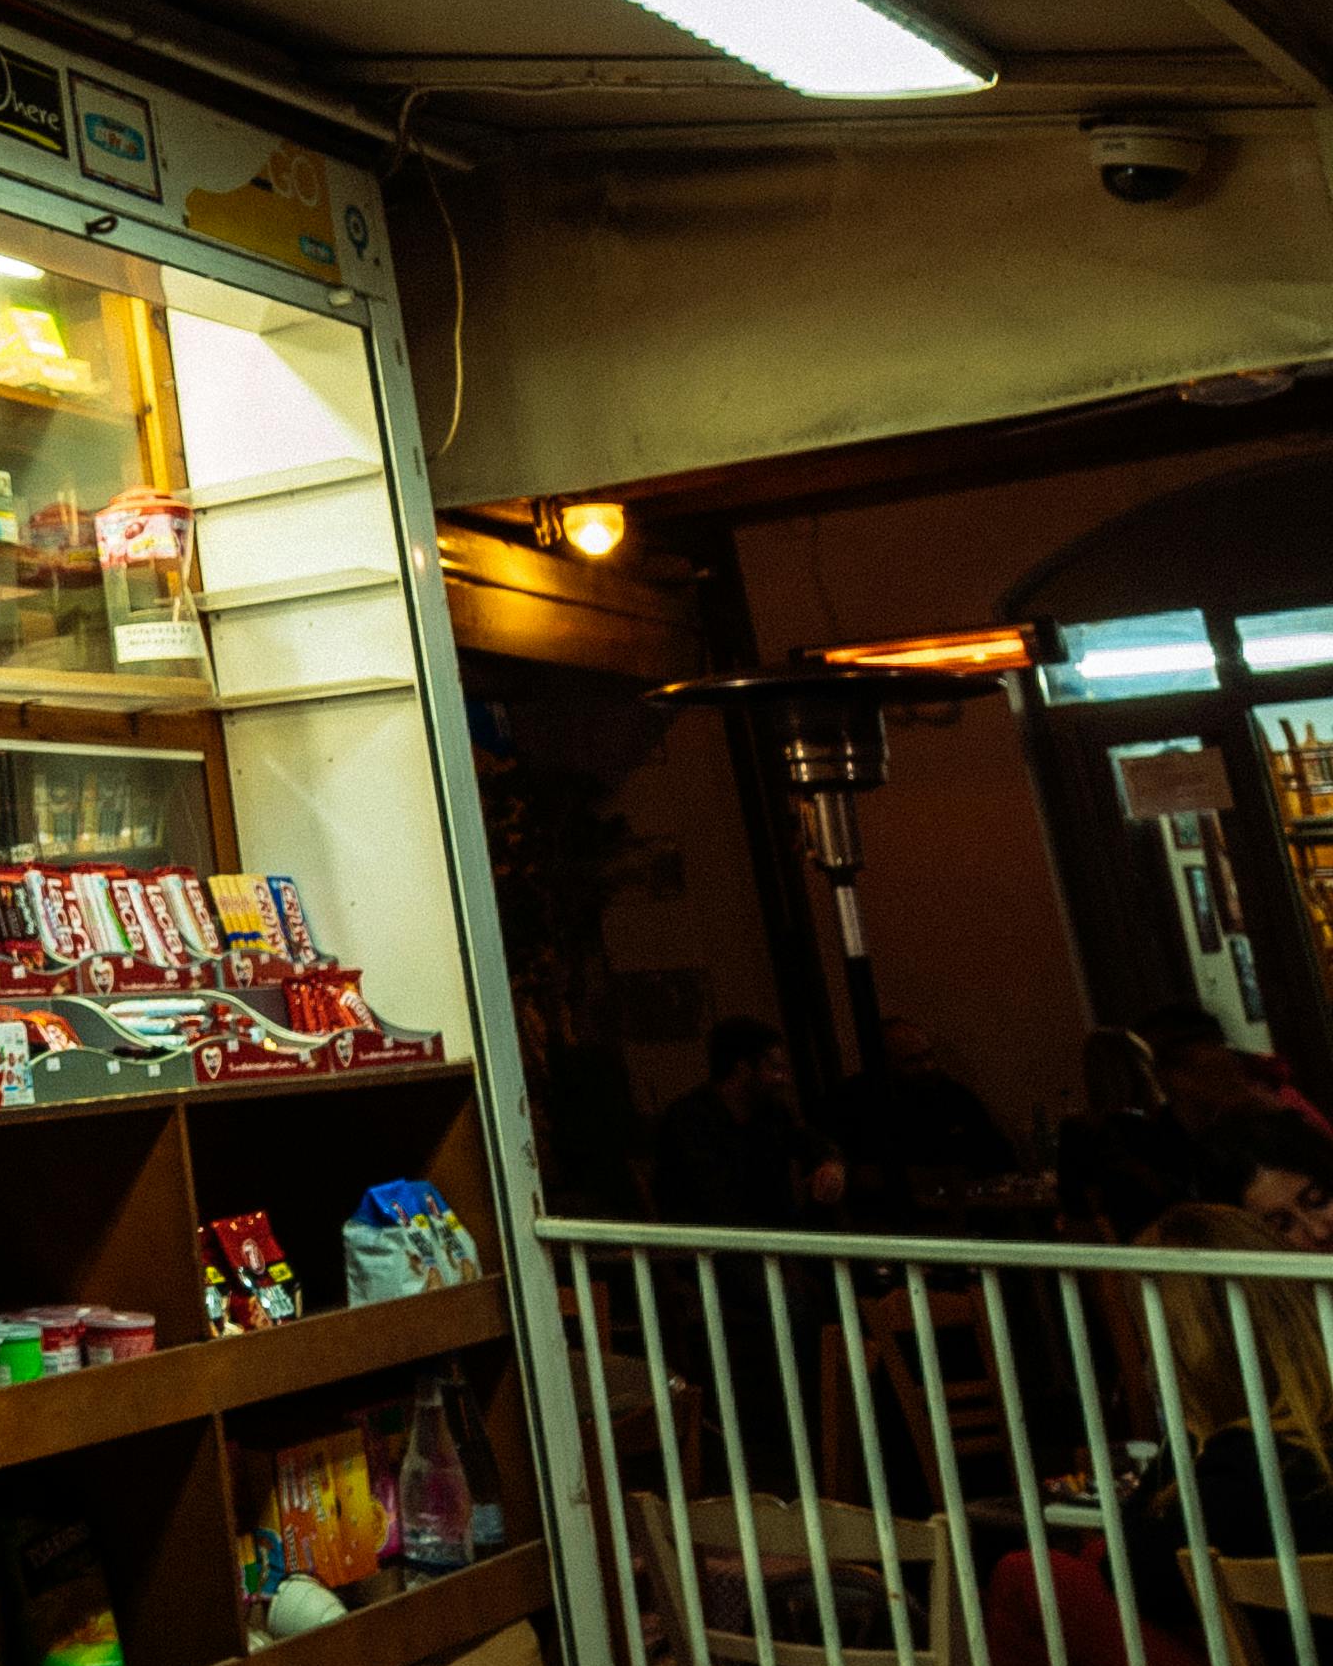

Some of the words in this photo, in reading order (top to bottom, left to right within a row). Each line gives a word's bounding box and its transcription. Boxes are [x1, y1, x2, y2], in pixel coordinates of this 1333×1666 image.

[12, 90, 62, 132] here
[46, 878, 75, 954] Lacta
[111, 879, 145, 952] Lacta
[145, 884, 183, 955] Lacta
[184, 879, 220, 950] Lacta
